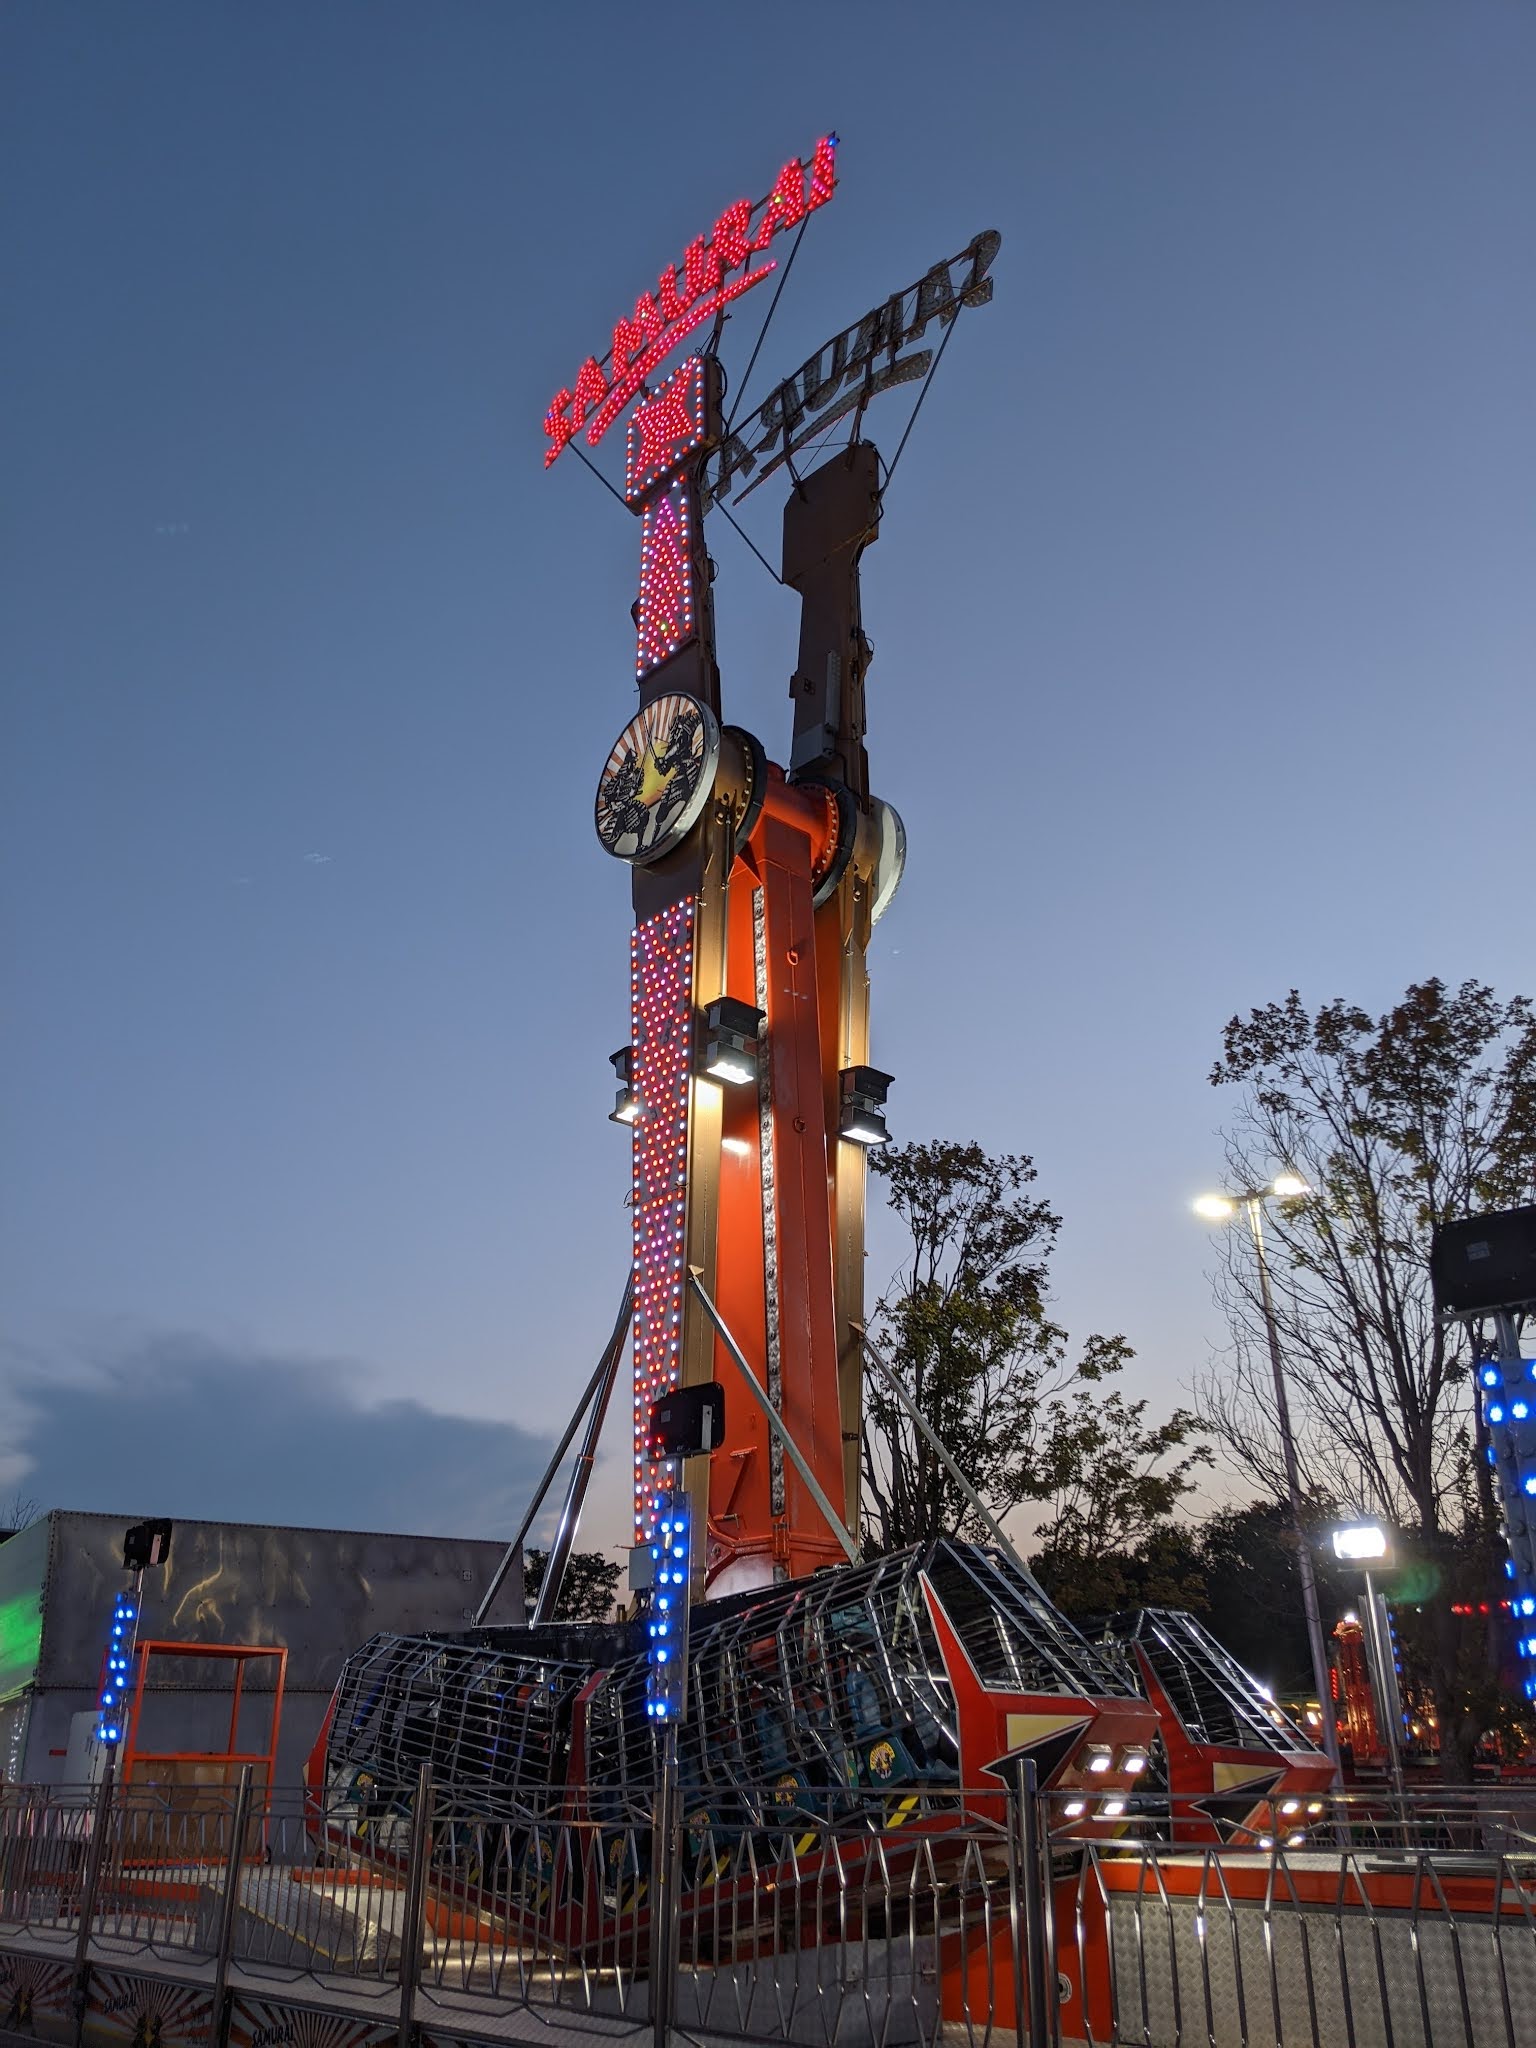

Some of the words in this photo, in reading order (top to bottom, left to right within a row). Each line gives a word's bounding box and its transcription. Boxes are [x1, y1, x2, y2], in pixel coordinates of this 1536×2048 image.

[544, 132, 839, 469] SAMURAI
[103, 1991, 137, 2014] SAMURAI
[252, 2023, 295, 2048] SAMURAI
